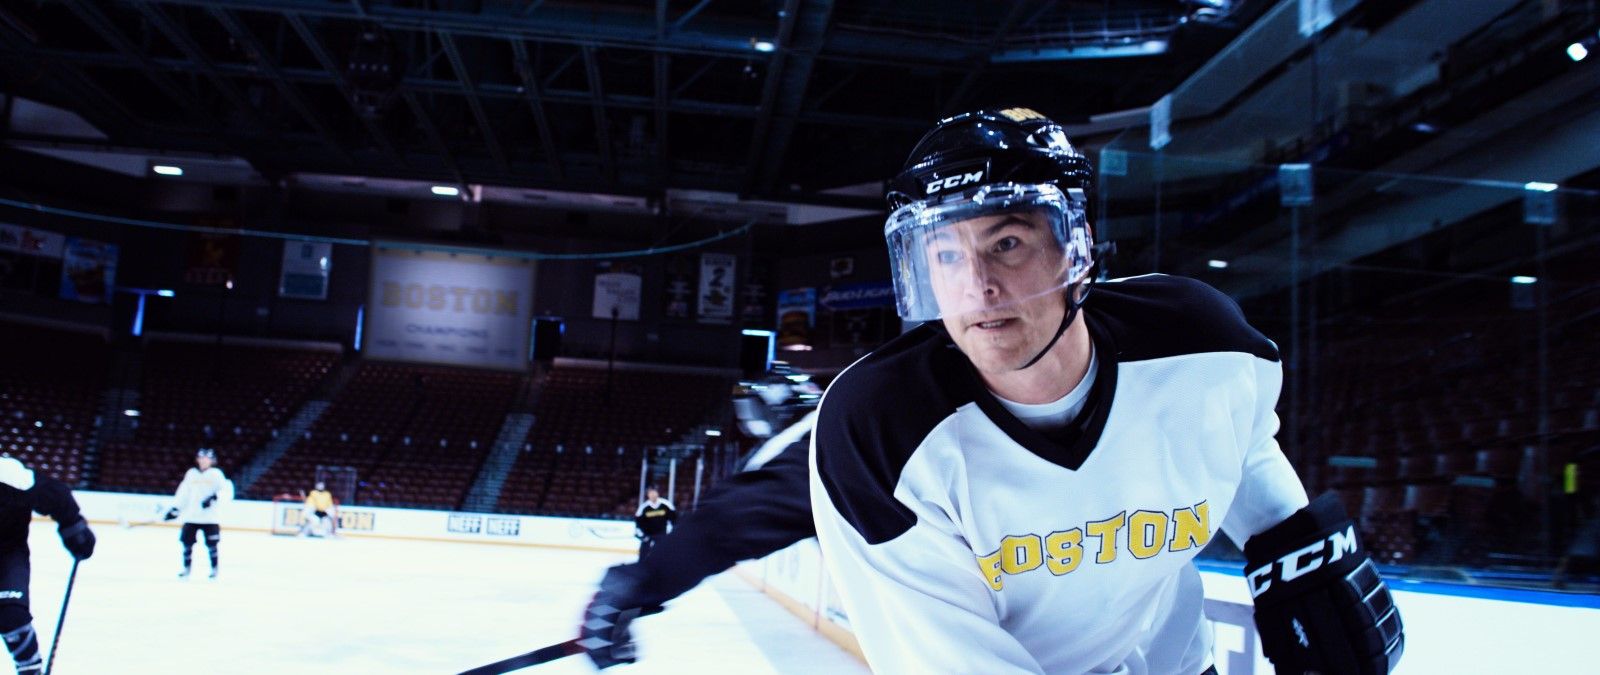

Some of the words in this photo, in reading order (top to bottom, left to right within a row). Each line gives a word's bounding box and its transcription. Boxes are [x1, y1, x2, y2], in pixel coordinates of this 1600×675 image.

[926, 169, 984, 195] CCM
[382, 281, 518, 316] BOSTON
[976, 498, 1211, 593] BOSTON
[1246, 524, 1358, 600] CCM
